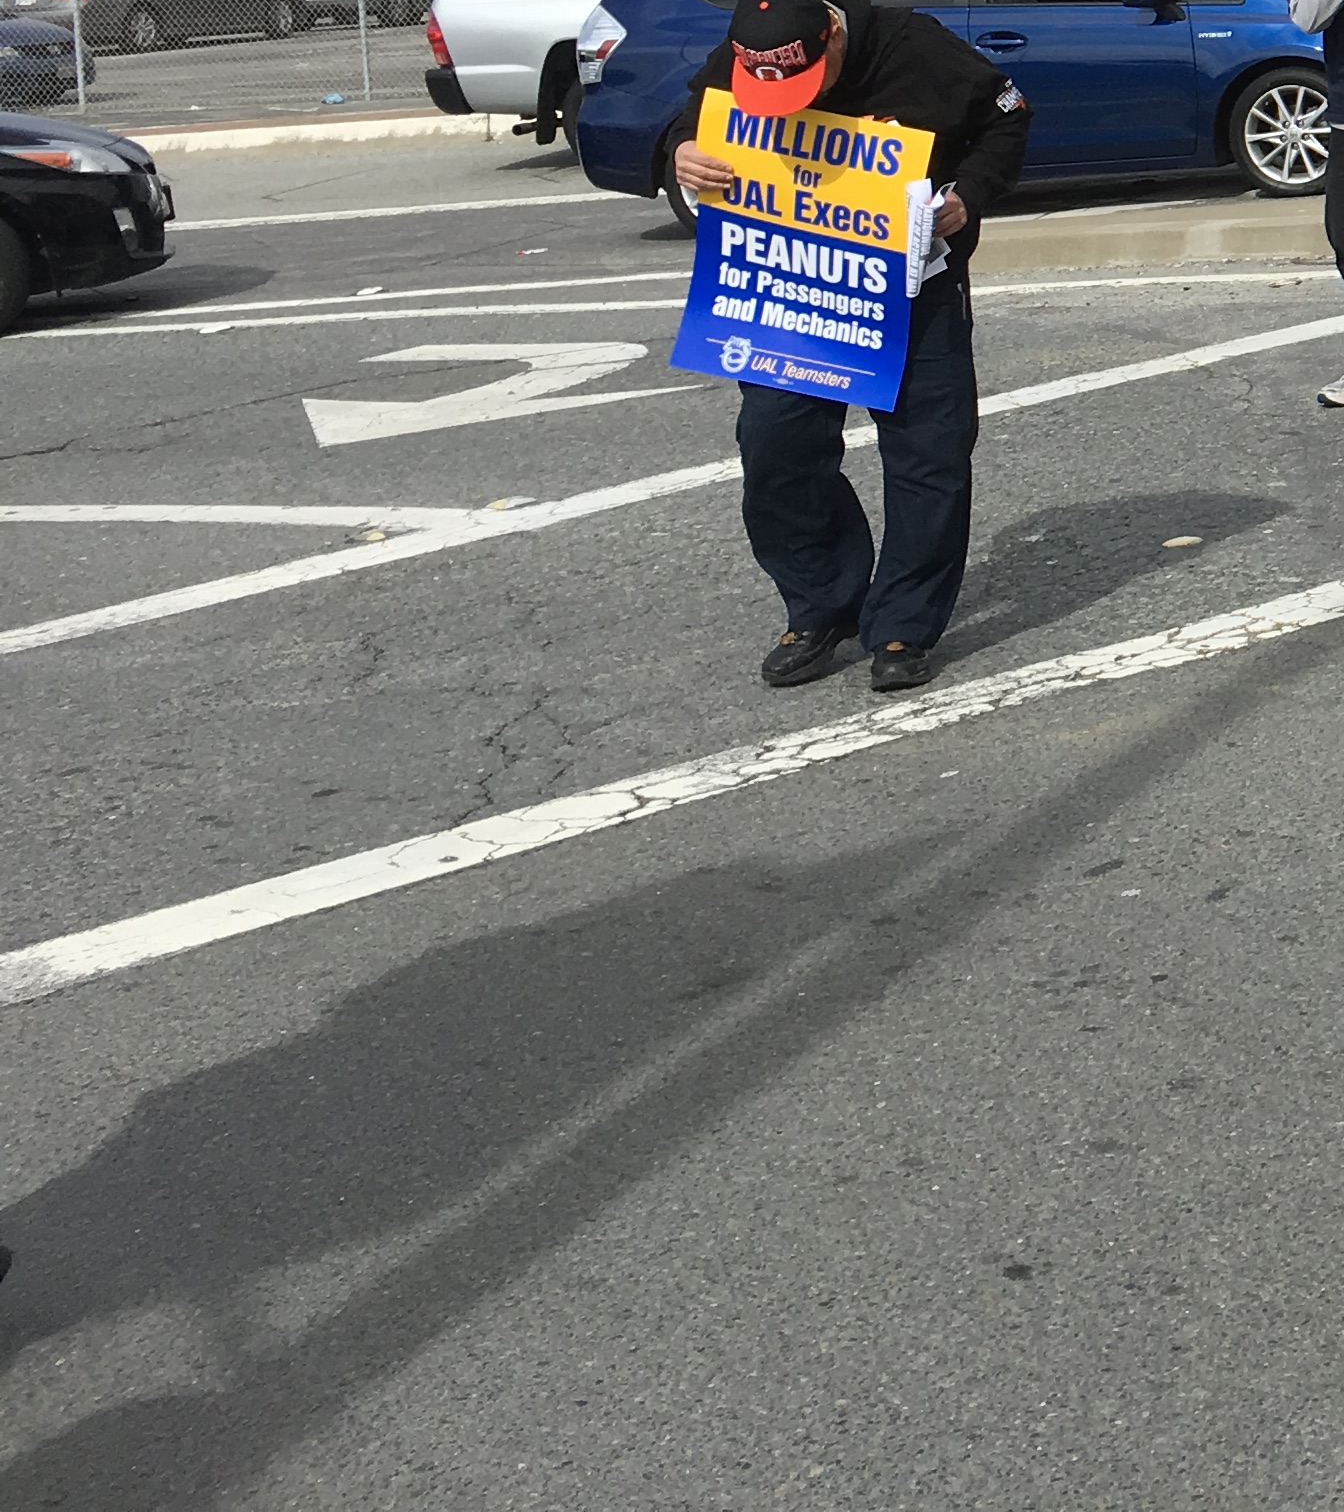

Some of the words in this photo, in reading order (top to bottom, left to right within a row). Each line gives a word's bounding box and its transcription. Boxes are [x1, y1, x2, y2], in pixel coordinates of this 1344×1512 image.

[726, 107, 902, 176] MILLIONS
[793, 164, 822, 189] for
[723, 176, 782, 217] UAL
[794, 190, 890, 240] Execs
[721, 221, 888, 294] PEANUTS
[719, 262, 751, 290] for
[757, 271, 885, 321] Passengers
[712, 295, 757, 322] and
[761, 301, 883, 350] Mechanics
[750, 354, 777, 376] UAL
[782, 360, 852, 389] Teamsters
